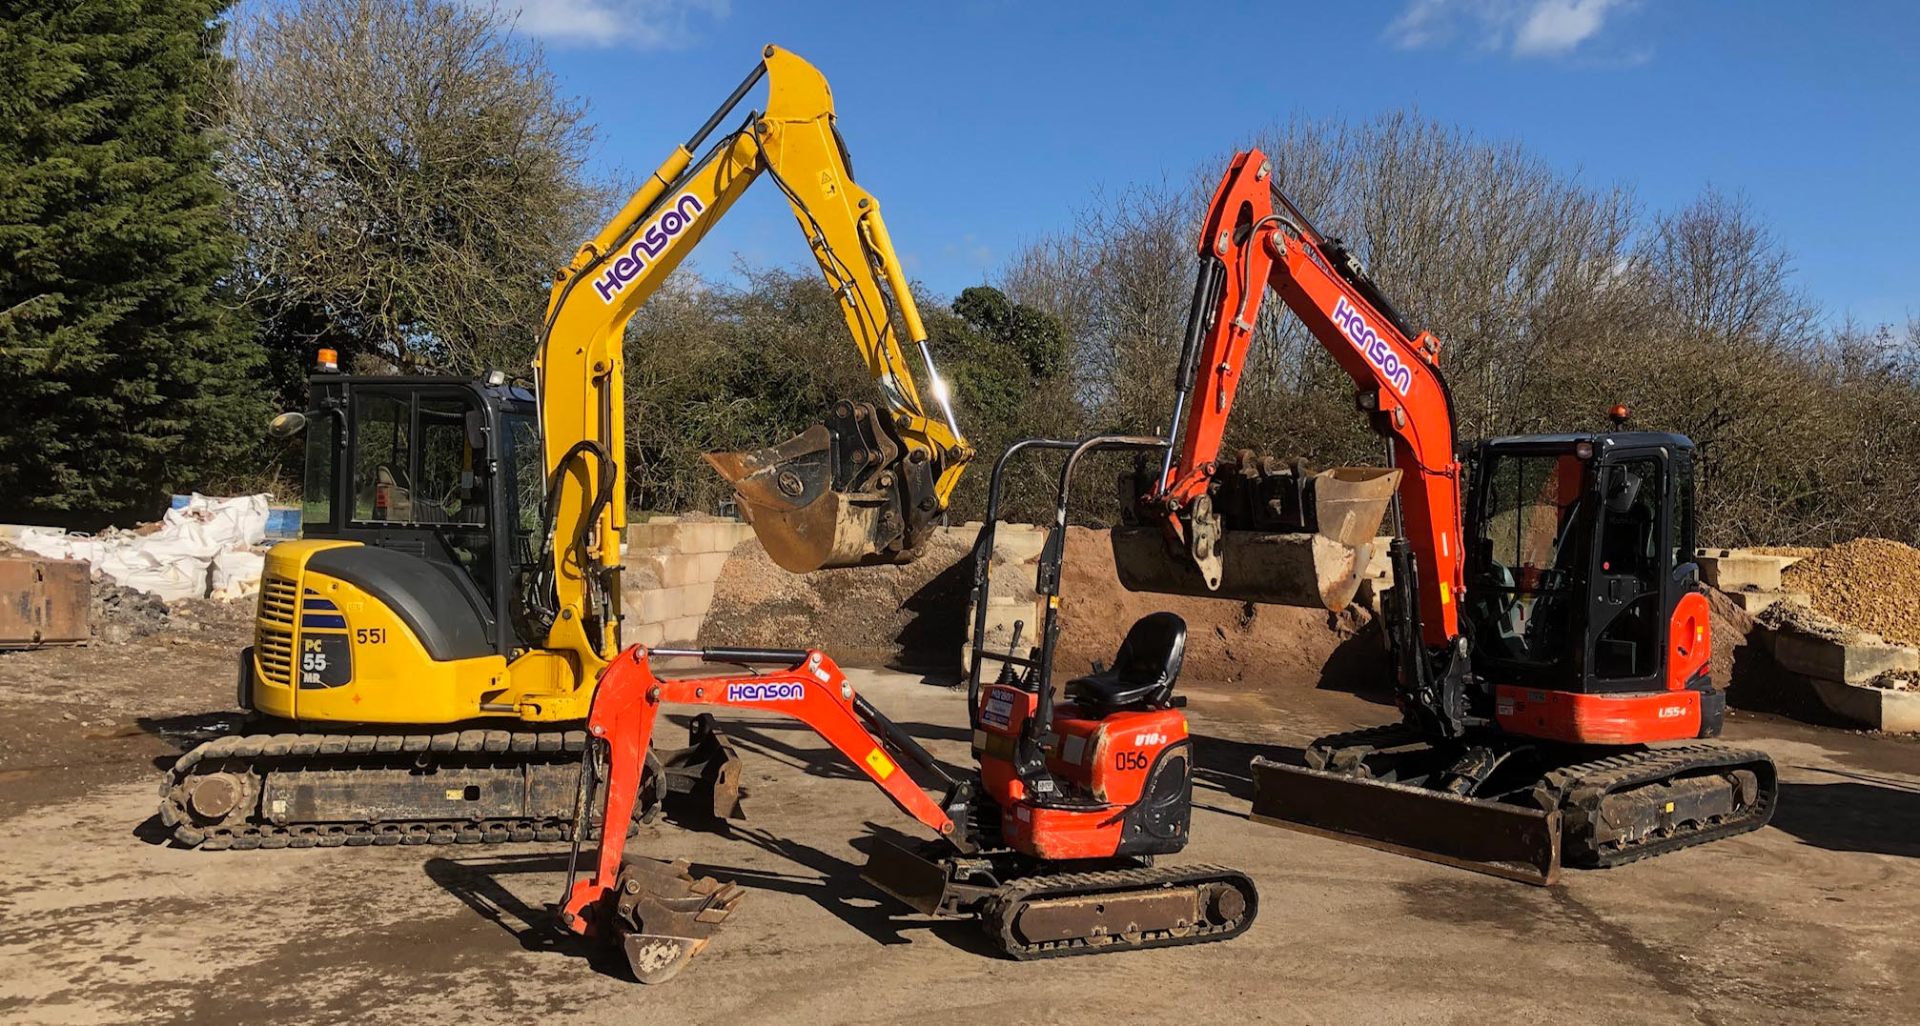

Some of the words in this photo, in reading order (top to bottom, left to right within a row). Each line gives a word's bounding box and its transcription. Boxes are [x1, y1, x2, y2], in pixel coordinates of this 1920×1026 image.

[594, 194, 703, 302] Henson
[1334, 299, 1410, 393] Henson
[356, 628, 386, 644] 551
[304, 639, 322, 652] PC
[303, 653, 327, 671] 55
[303, 672, 320, 683] MR
[729, 684, 803, 700] Henson
[1115, 751, 1148, 771] 056
